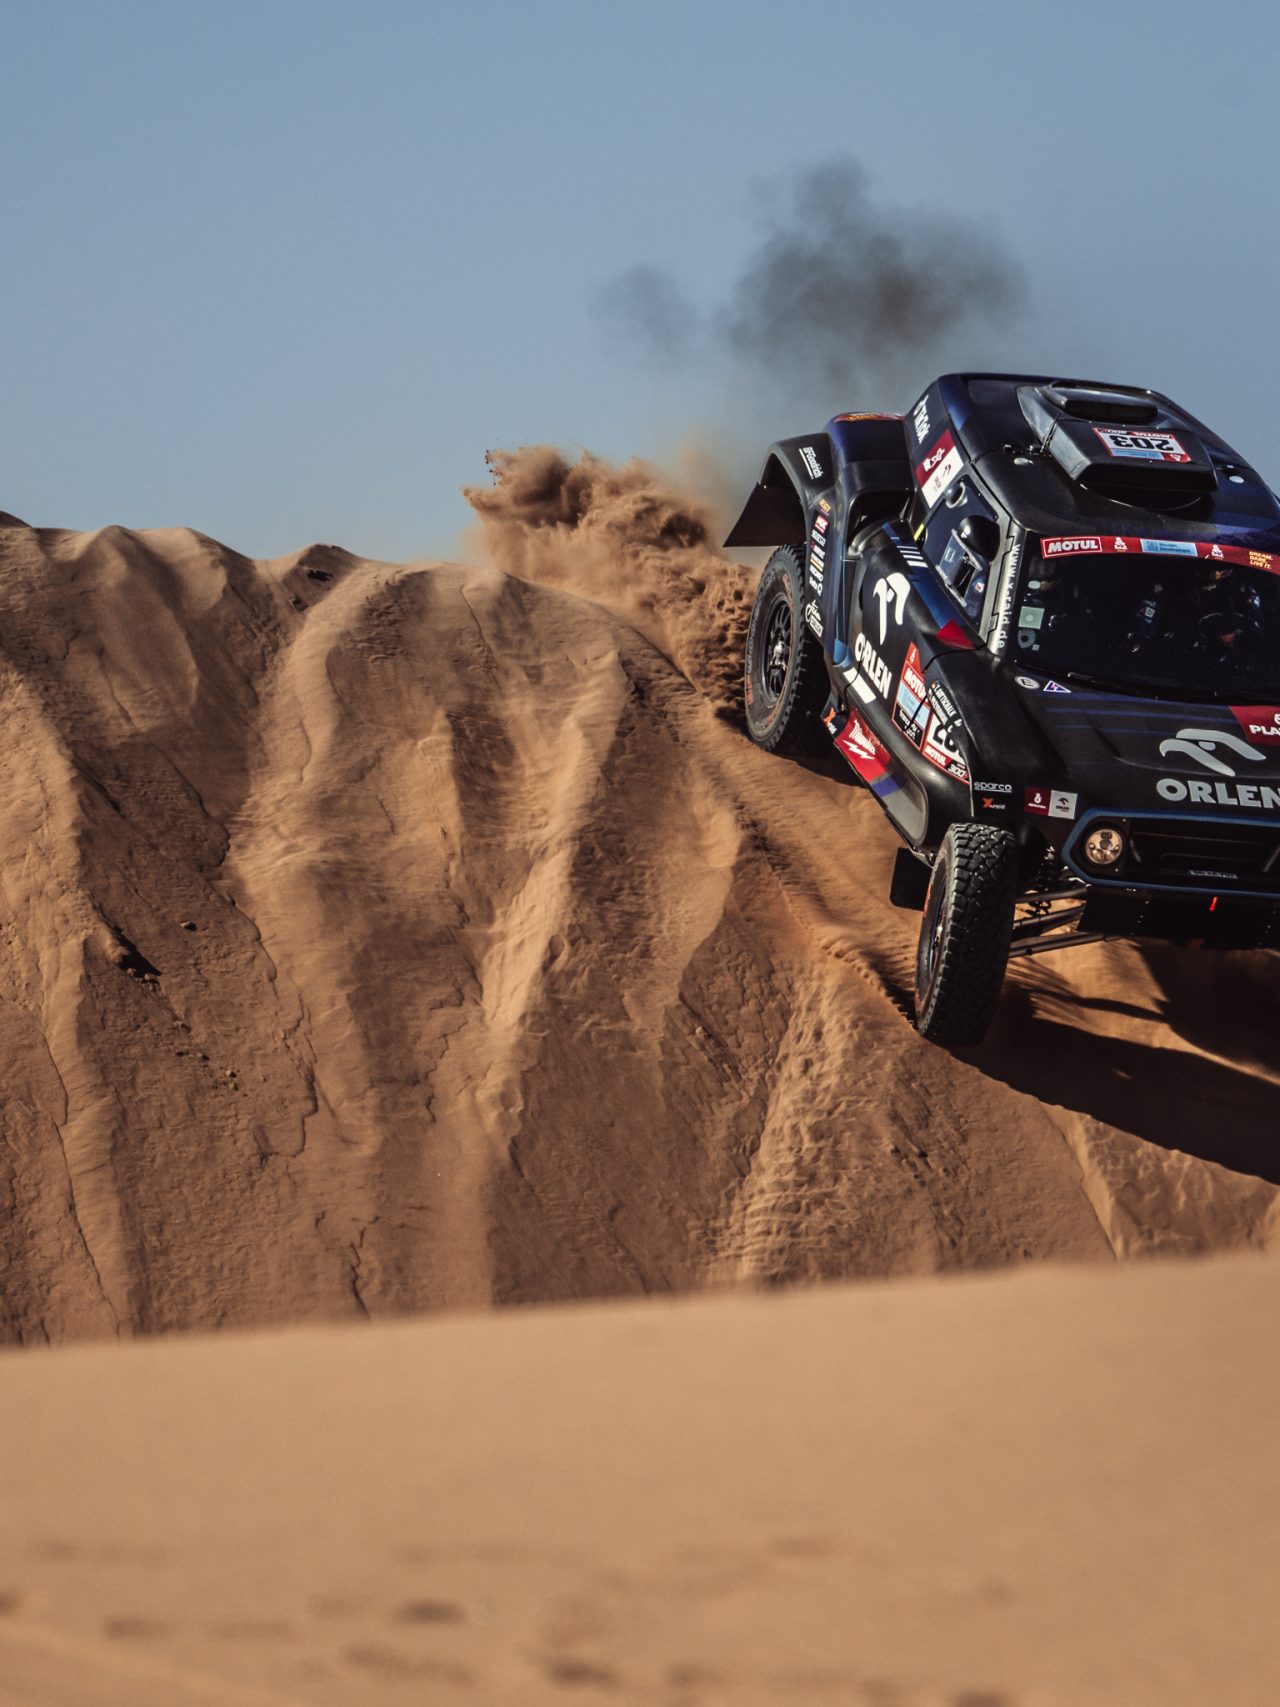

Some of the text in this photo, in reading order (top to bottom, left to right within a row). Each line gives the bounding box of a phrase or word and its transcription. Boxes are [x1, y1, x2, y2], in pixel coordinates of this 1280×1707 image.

[1109, 435, 1175, 451] 203
[1048, 540, 1098, 553] MOTUL
[1250, 560, 1265, 568] LIVE
[855, 632, 893, 700] ORLEN
[925, 745, 947, 767] MOTUL
[974, 782, 1012, 793] sparco
